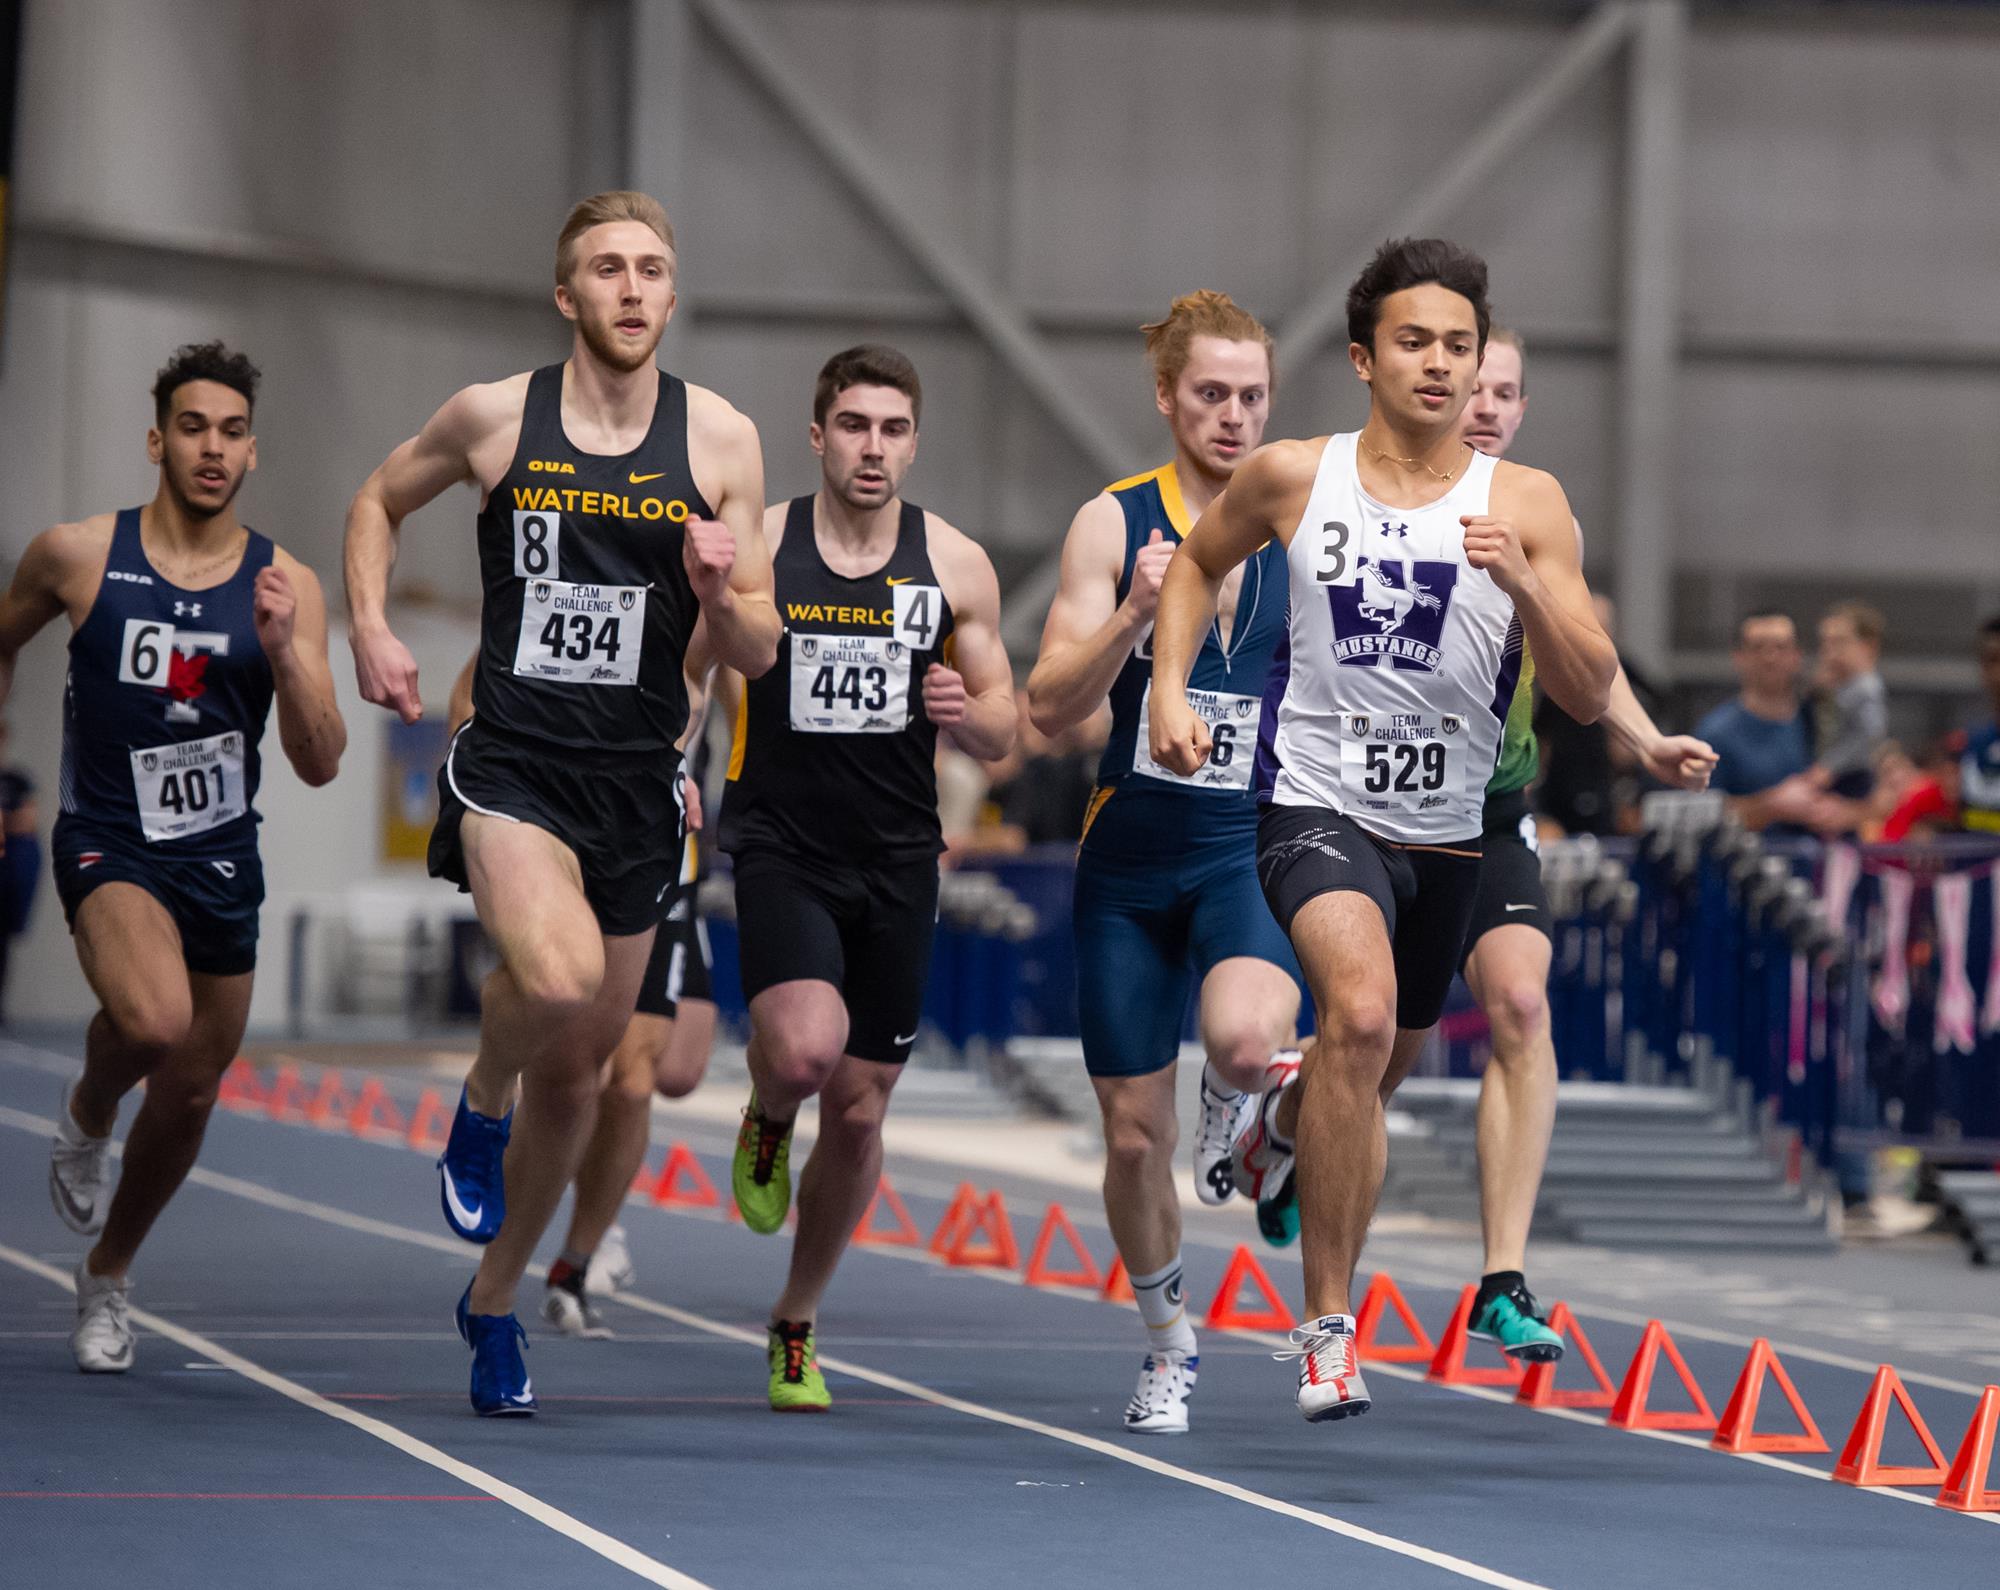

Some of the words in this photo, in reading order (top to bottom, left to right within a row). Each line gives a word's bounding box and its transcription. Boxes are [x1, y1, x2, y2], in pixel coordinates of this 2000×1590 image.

[528, 460, 575, 474] OUA
[513, 488, 689, 523] WATERLOO
[522, 515, 549, 575] 8
[1316, 521, 1349, 582] 3
[107, 571, 154, 585] OUA
[570, 586, 600, 599] TEAM
[554, 598, 613, 613] CHALLENGE
[787, 604, 895, 625] WATERLO
[903, 590, 932, 645] 4
[540, 613, 621, 662] 434
[838, 639, 865, 649] TEAM
[131, 625, 160, 680] 6
[822, 651, 880, 663] CHALLENGE
[1332, 636, 1440, 667] MUSTANGS
[811, 666, 887, 711] 443
[1187, 692, 1217, 705] TEAM
[1391, 715, 1421, 727] TEAM
[1375, 727, 1436, 741] CHALLENGE
[176, 742, 204, 757] TEAM
[163, 753, 219, 770] CHALLENGE
[1365, 743, 1446, 793] 529
[160, 764, 225, 816] 401
